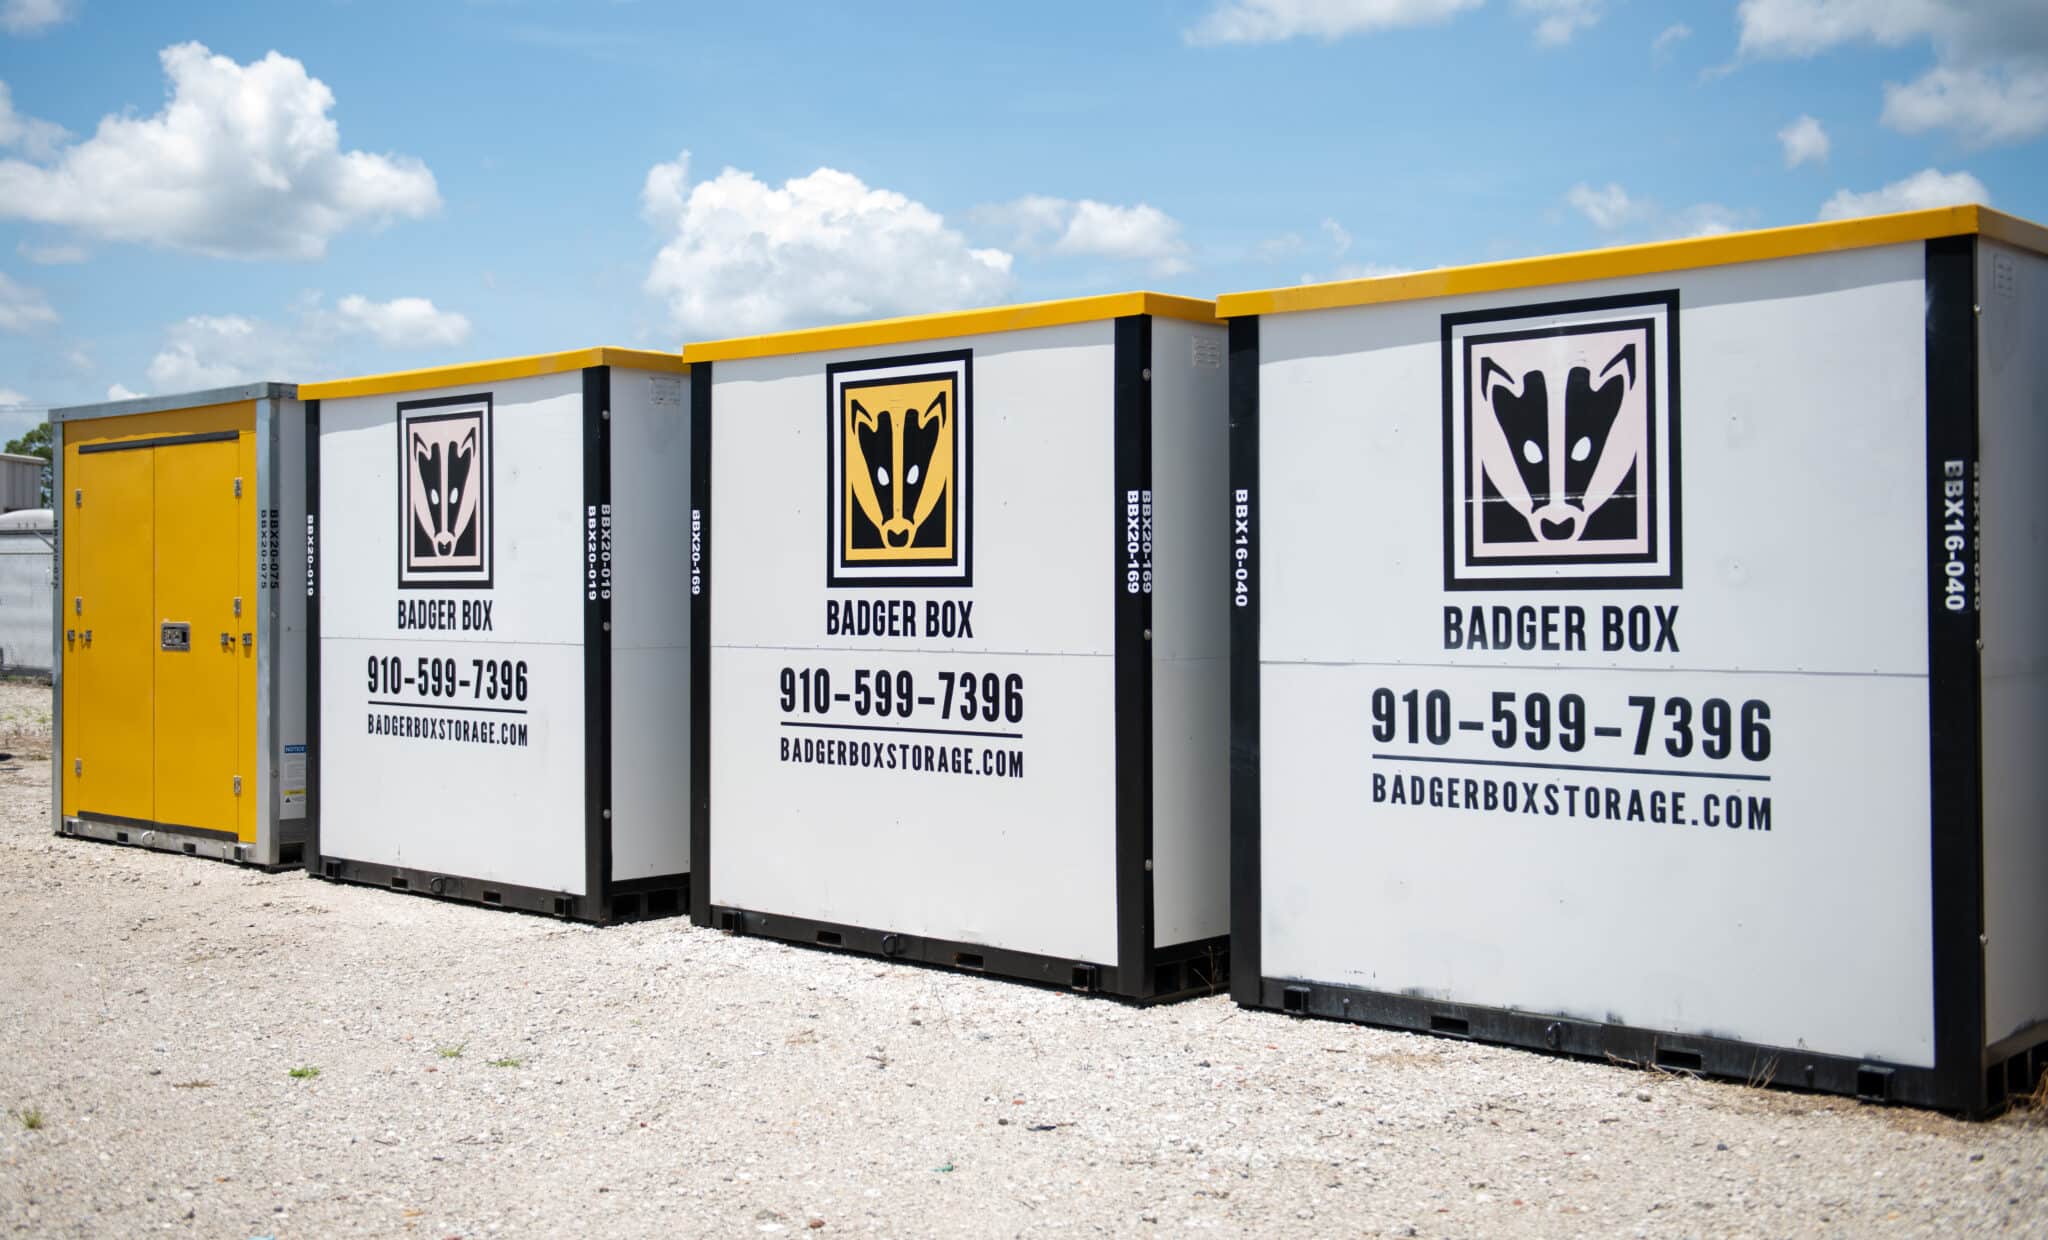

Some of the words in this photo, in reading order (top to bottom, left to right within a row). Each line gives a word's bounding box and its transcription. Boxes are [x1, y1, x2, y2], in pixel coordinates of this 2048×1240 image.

[270, 509, 279, 589] BBX20-075
[588, 505, 597, 601] BBX20-019
[601, 504, 611, 600] BBX20-019
[692, 509, 701, 595] BBX20-169
[1127, 490, 1139, 594] BBX20-169
[1142, 490, 1152, 594] BBX20-169
[1235, 489, 1248, 607] BBX16-040
[1944, 460, 1965, 611] BBX16-040
[397, 599, 457, 631] BADGER
[462, 600, 493, 632] BOX
[826, 599, 917, 637] BADGER
[925, 600, 974, 639] BOX
[1443, 605, 1587, 652] BADGER
[1602, 604, 1680, 653] BOX
[367, 655, 528, 702] 910-599-7396
[780, 667, 1024, 724] 910-599-7396
[367, 713, 528, 747] BADGERBOXSTORAGE.COM
[780, 736, 1024, 778] BADGERBOXSTORAGE.COM
[1372, 687, 1772, 762] 910-599-7396
[1372, 773, 1772, 832] BADGERBOXSTORAGE.COM
